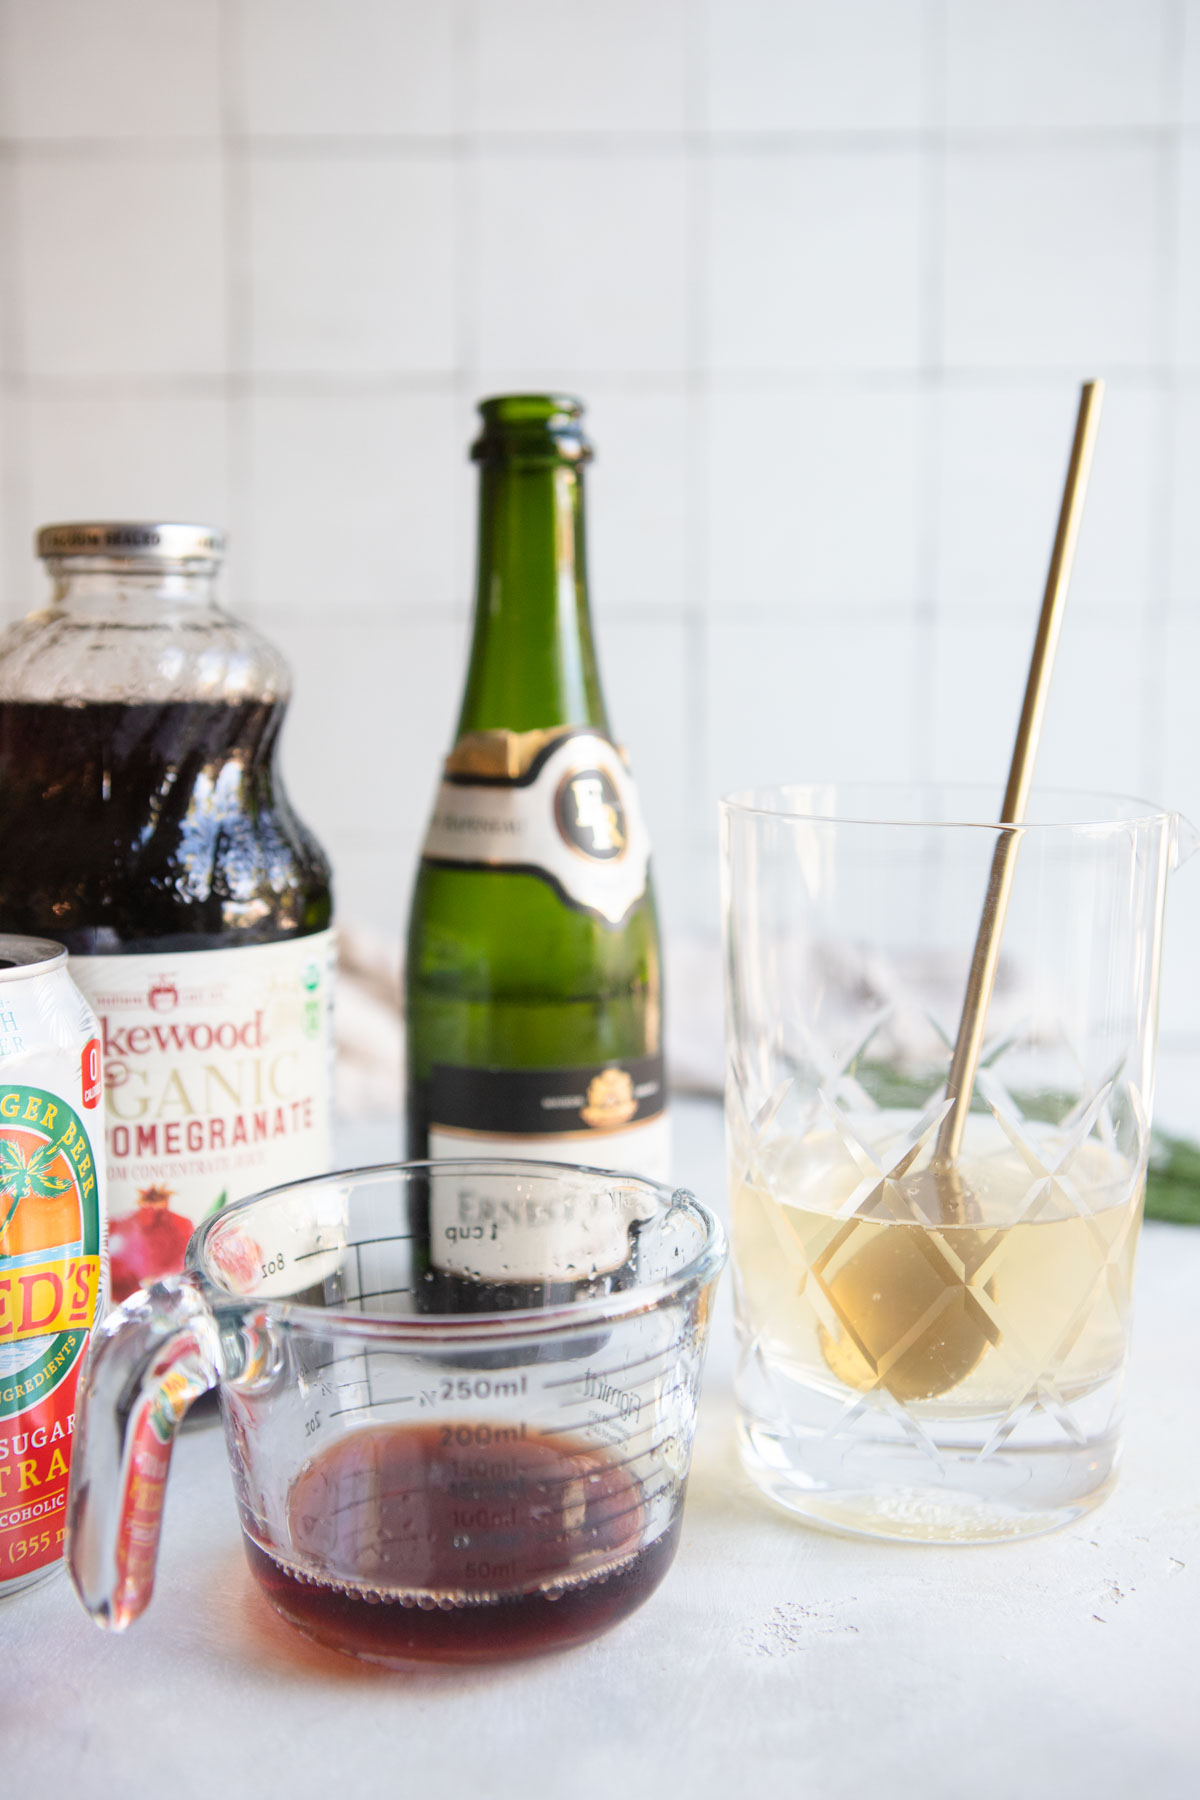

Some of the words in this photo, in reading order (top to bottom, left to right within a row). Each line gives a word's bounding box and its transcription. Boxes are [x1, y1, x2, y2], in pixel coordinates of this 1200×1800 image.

[105, 1096, 313, 1159] OMEGRANATE
[61, 1121, 95, 1199] BEER
[441, 1375, 527, 1400] 250ml
[0, 1413, 76, 1460] SUGAR
[441, 1421, 526, 1447] 200ml
[8, 1531, 50, 1564] (355
